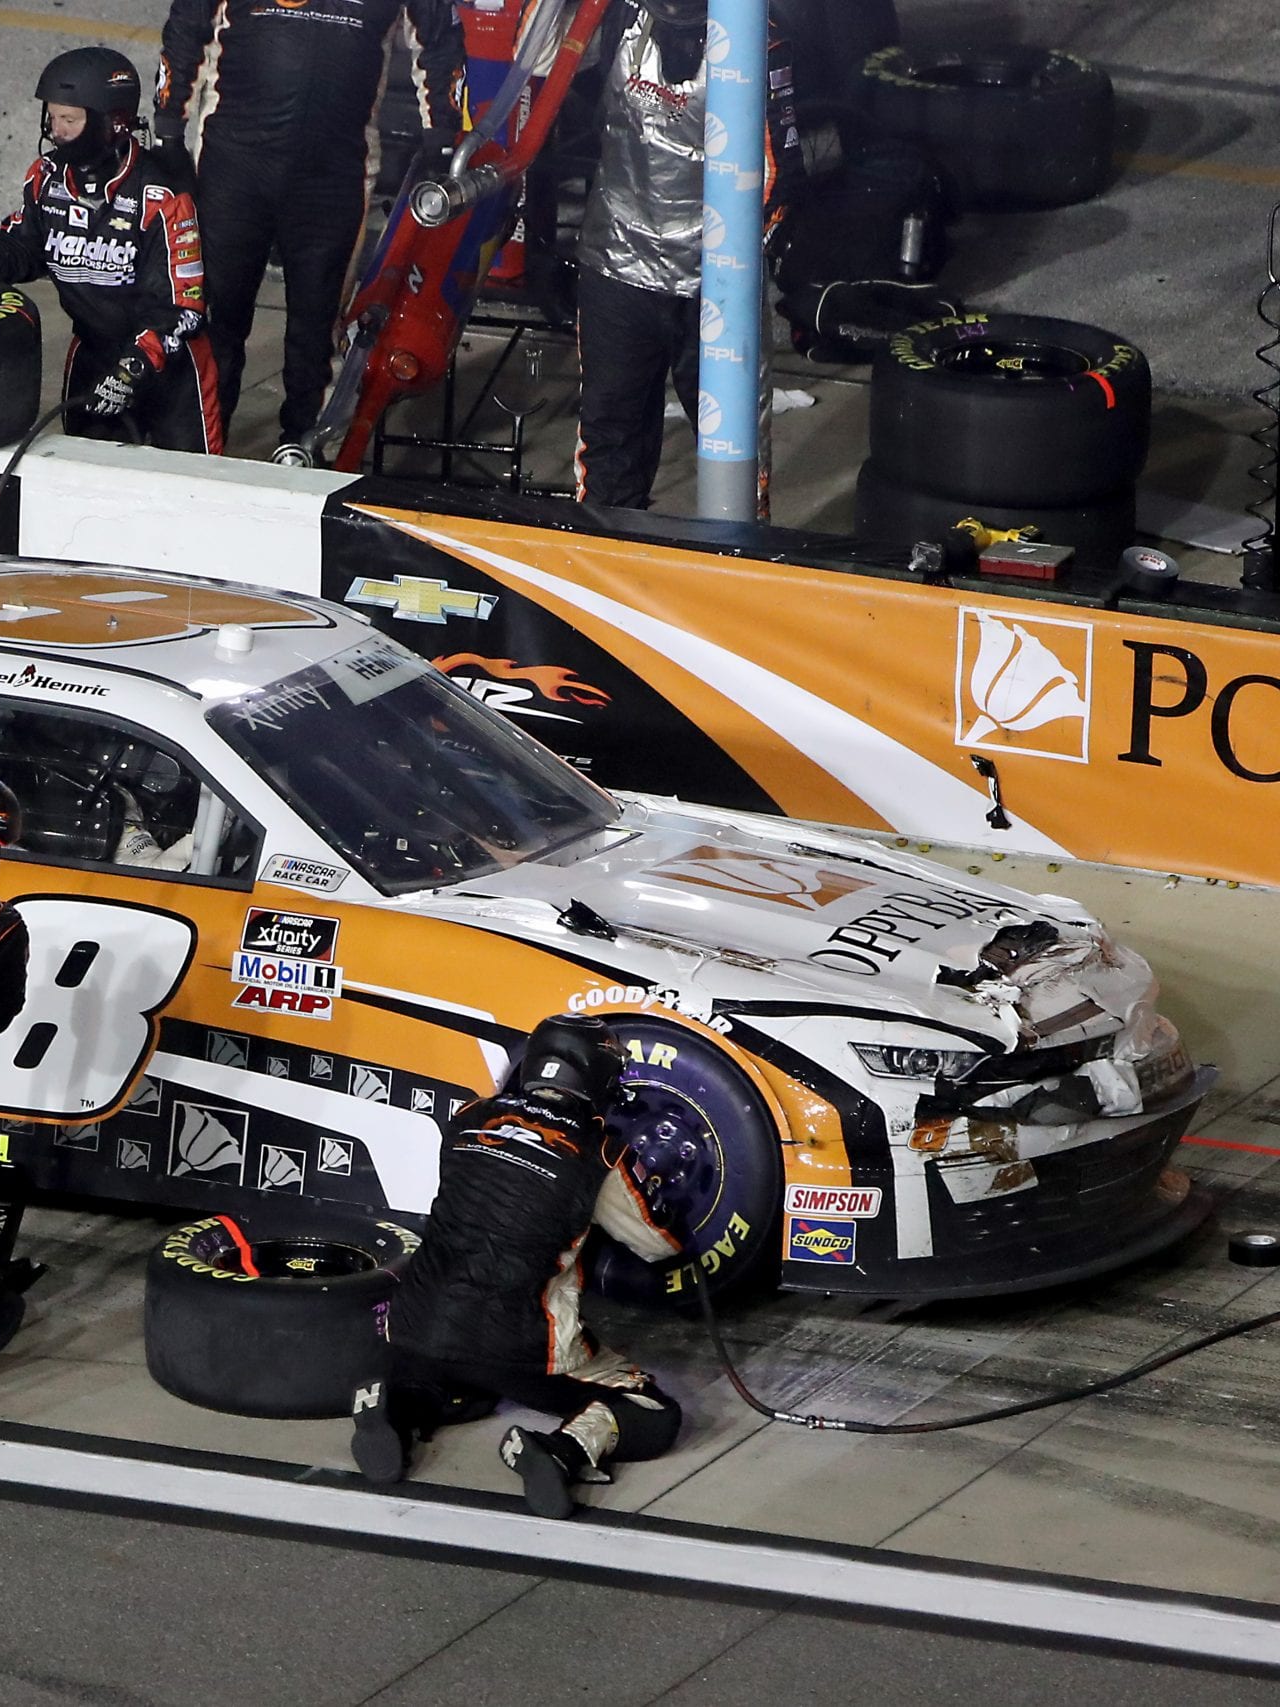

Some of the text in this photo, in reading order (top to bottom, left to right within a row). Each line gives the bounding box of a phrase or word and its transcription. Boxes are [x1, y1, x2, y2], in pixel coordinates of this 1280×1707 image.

[710, 66, 750, 84] FPL
[44, 228, 139, 265] Hendrick
[706, 254, 747, 270] FPL
[704, 346, 744, 363] FPL
[702, 437, 742, 455] FPL
[31, 675, 111, 697] Hemric
[272, 869, 330, 888] RACE CAR
[291, 860, 337, 879] NASCAR
[282, 915, 314, 928] NASCAR
[256, 923, 322, 953] xfinity
[275, 943, 303, 956] SERIES
[239, 954, 308, 986] Mobil
[236, 985, 332, 1014] ARP
[540, 1063, 560, 1079] 8
[79, 1098, 95, 1109] TM
[792, 1188, 874, 1212] SIMPSON
[793, 1233, 851, 1250] SUNOCO
[353, 1382, 382, 1415] N
